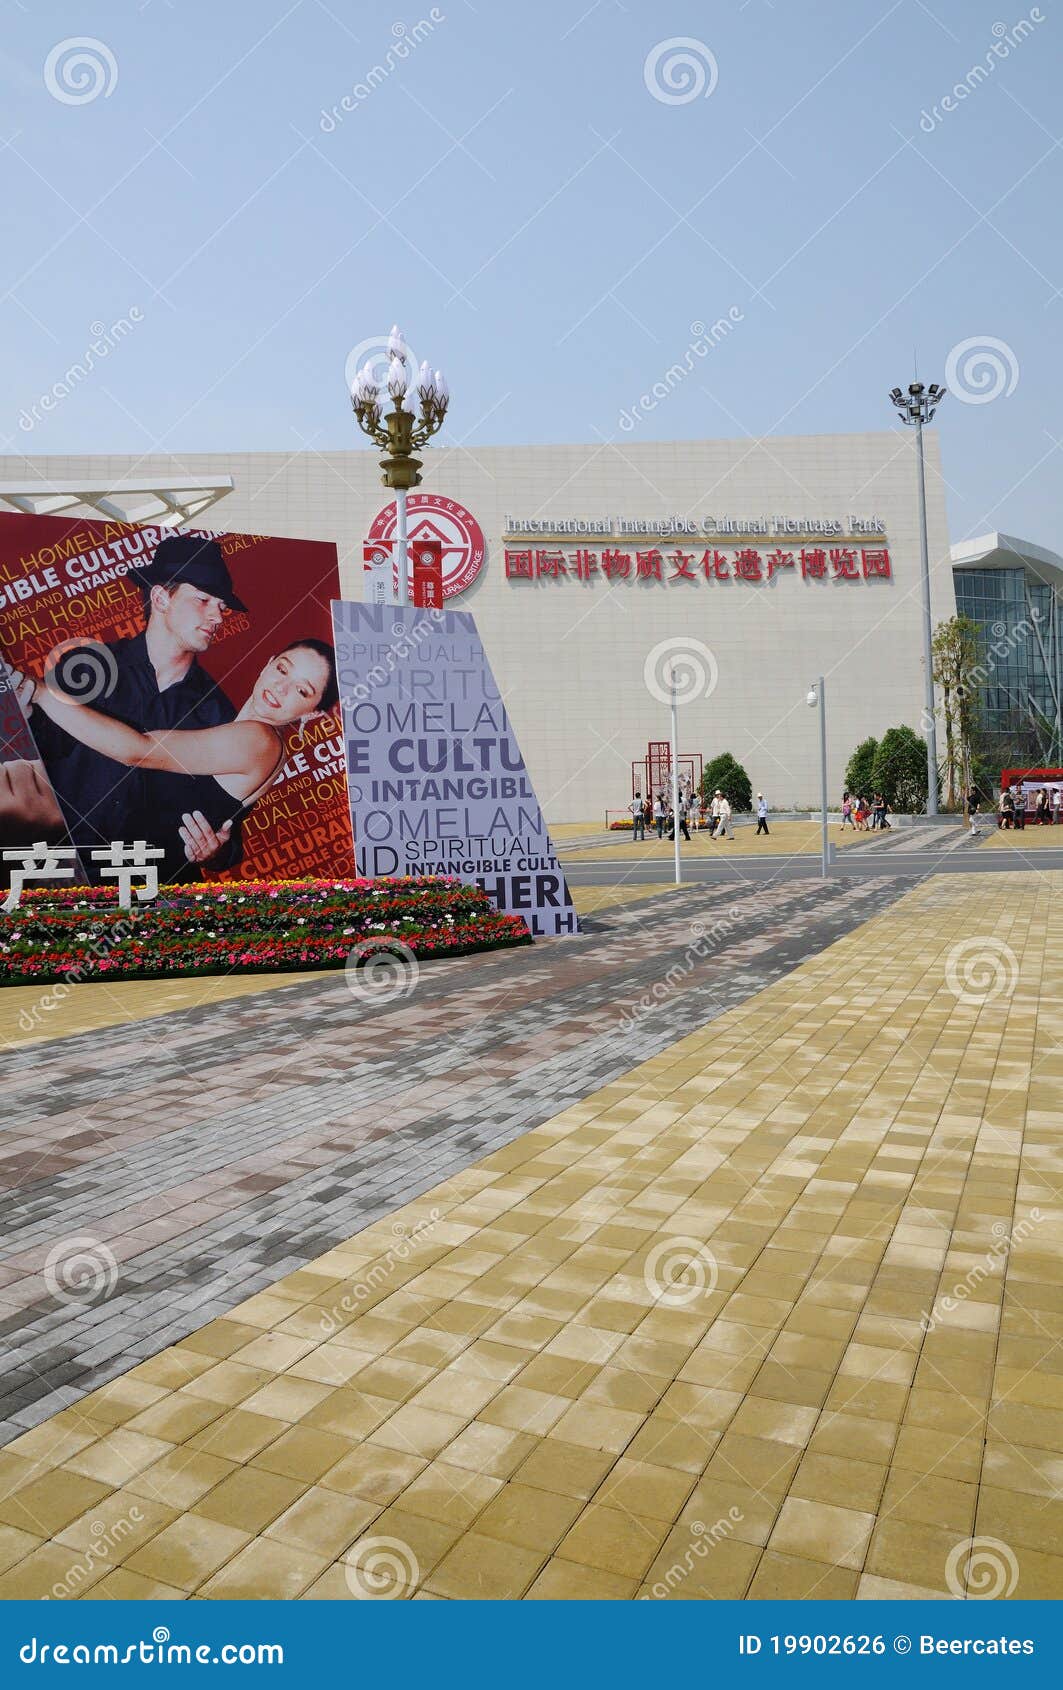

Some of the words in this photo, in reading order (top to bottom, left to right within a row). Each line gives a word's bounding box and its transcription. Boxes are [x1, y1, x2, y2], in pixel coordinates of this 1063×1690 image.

[504, 515, 612, 533] International
[617, 515, 697, 537] Intangible
[702, 515, 767, 533] Cultural
[771, 515, 841, 537] Heritage
[848, 515, 885, 533] Park
[20, 521, 146, 574] HOMELAN
[504, 547, 892, 581] 国际非物质文化遗产博览园
[50, 580, 140, 627] HOMEL
[404, 836, 537, 861] SPIRITUAL
[0, 840, 165, 914] 产节
[405, 857, 511, 877] INTANGIBLE
